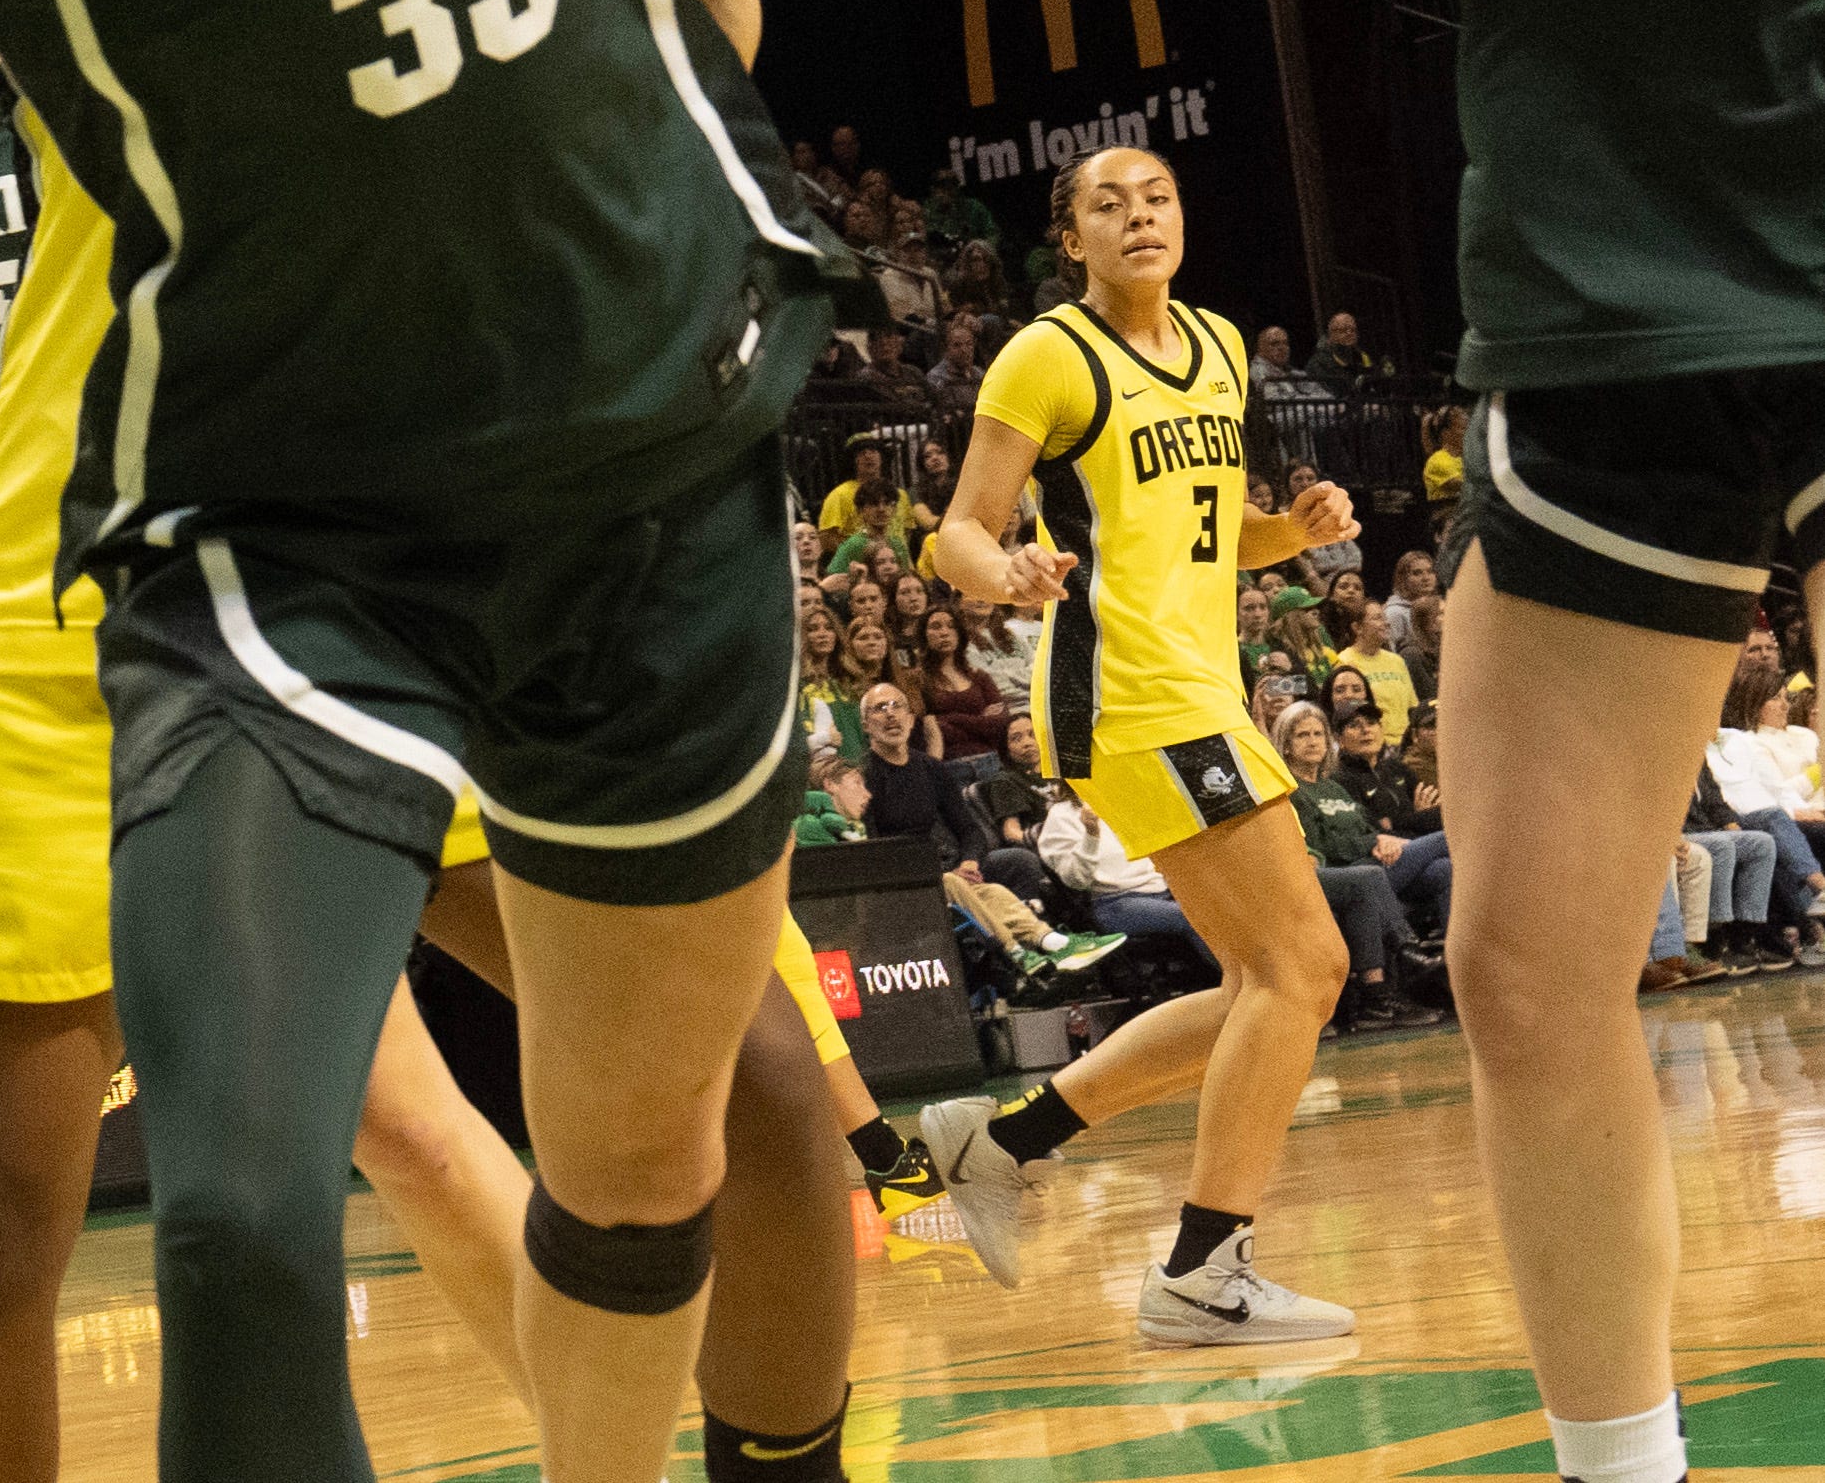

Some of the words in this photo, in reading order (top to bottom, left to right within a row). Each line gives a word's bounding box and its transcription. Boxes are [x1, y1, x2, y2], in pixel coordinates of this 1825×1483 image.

[947, 135, 1021, 187] i'm
[1027, 93, 1161, 171] lovin'
[1169, 85, 1211, 142] it
[1190, 485, 1219, 564] 3
[858, 958, 951, 995] TOYOTA
